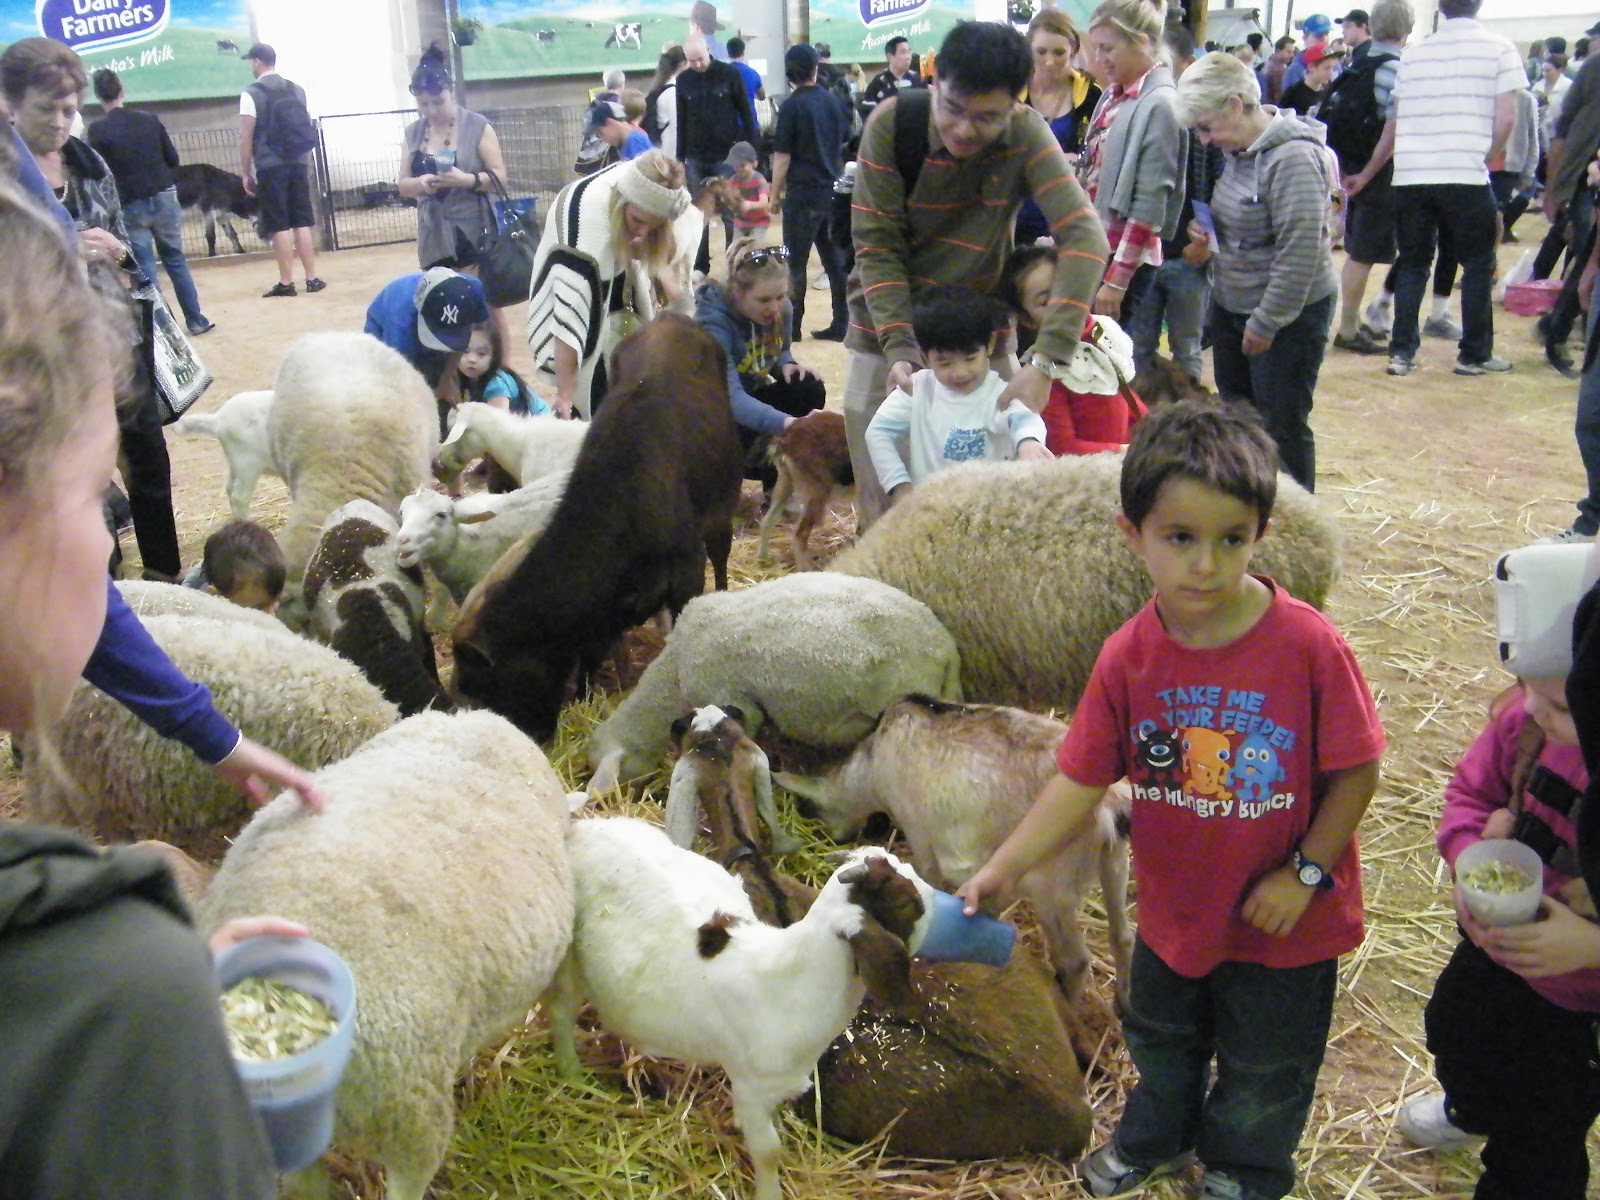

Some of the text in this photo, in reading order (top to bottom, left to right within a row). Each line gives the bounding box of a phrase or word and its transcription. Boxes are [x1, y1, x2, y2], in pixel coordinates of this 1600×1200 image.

[870, 0, 924, 15] Farme
[61, 4, 154, 39] Farmers
[140, 44, 174, 67] Milk
[440, 304, 459, 324] NY
[1156, 686, 1266, 713] TAKE ME
[1161, 708, 1214, 729] YOUR
[1131, 783, 1161, 801] he
[1165, 787, 1234, 818] Hungry
